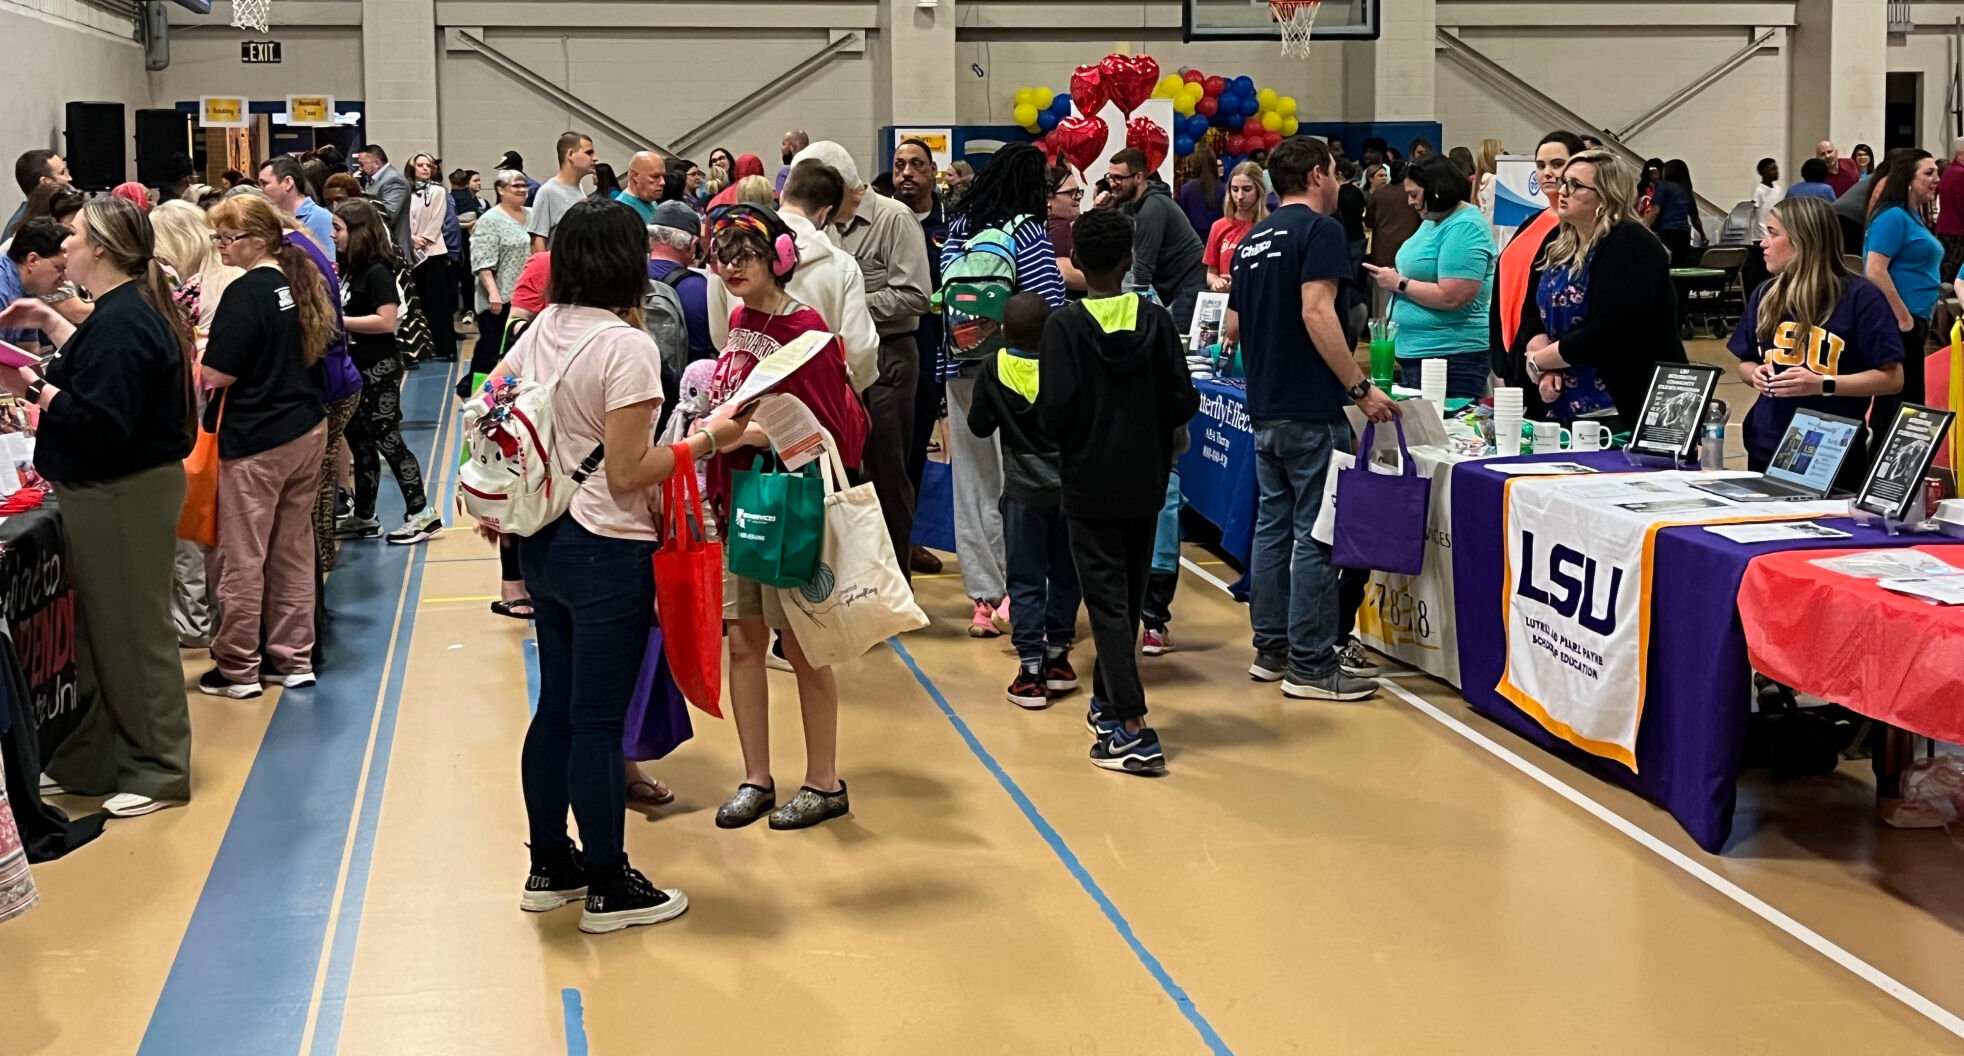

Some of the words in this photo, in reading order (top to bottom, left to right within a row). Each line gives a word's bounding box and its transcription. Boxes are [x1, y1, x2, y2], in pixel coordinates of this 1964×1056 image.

[250, 43, 274, 62] EXIT
[1763, 321, 1845, 376] SU
[1517, 530, 1623, 636] LSU
[1560, 651, 1598, 680] EDUCATION
